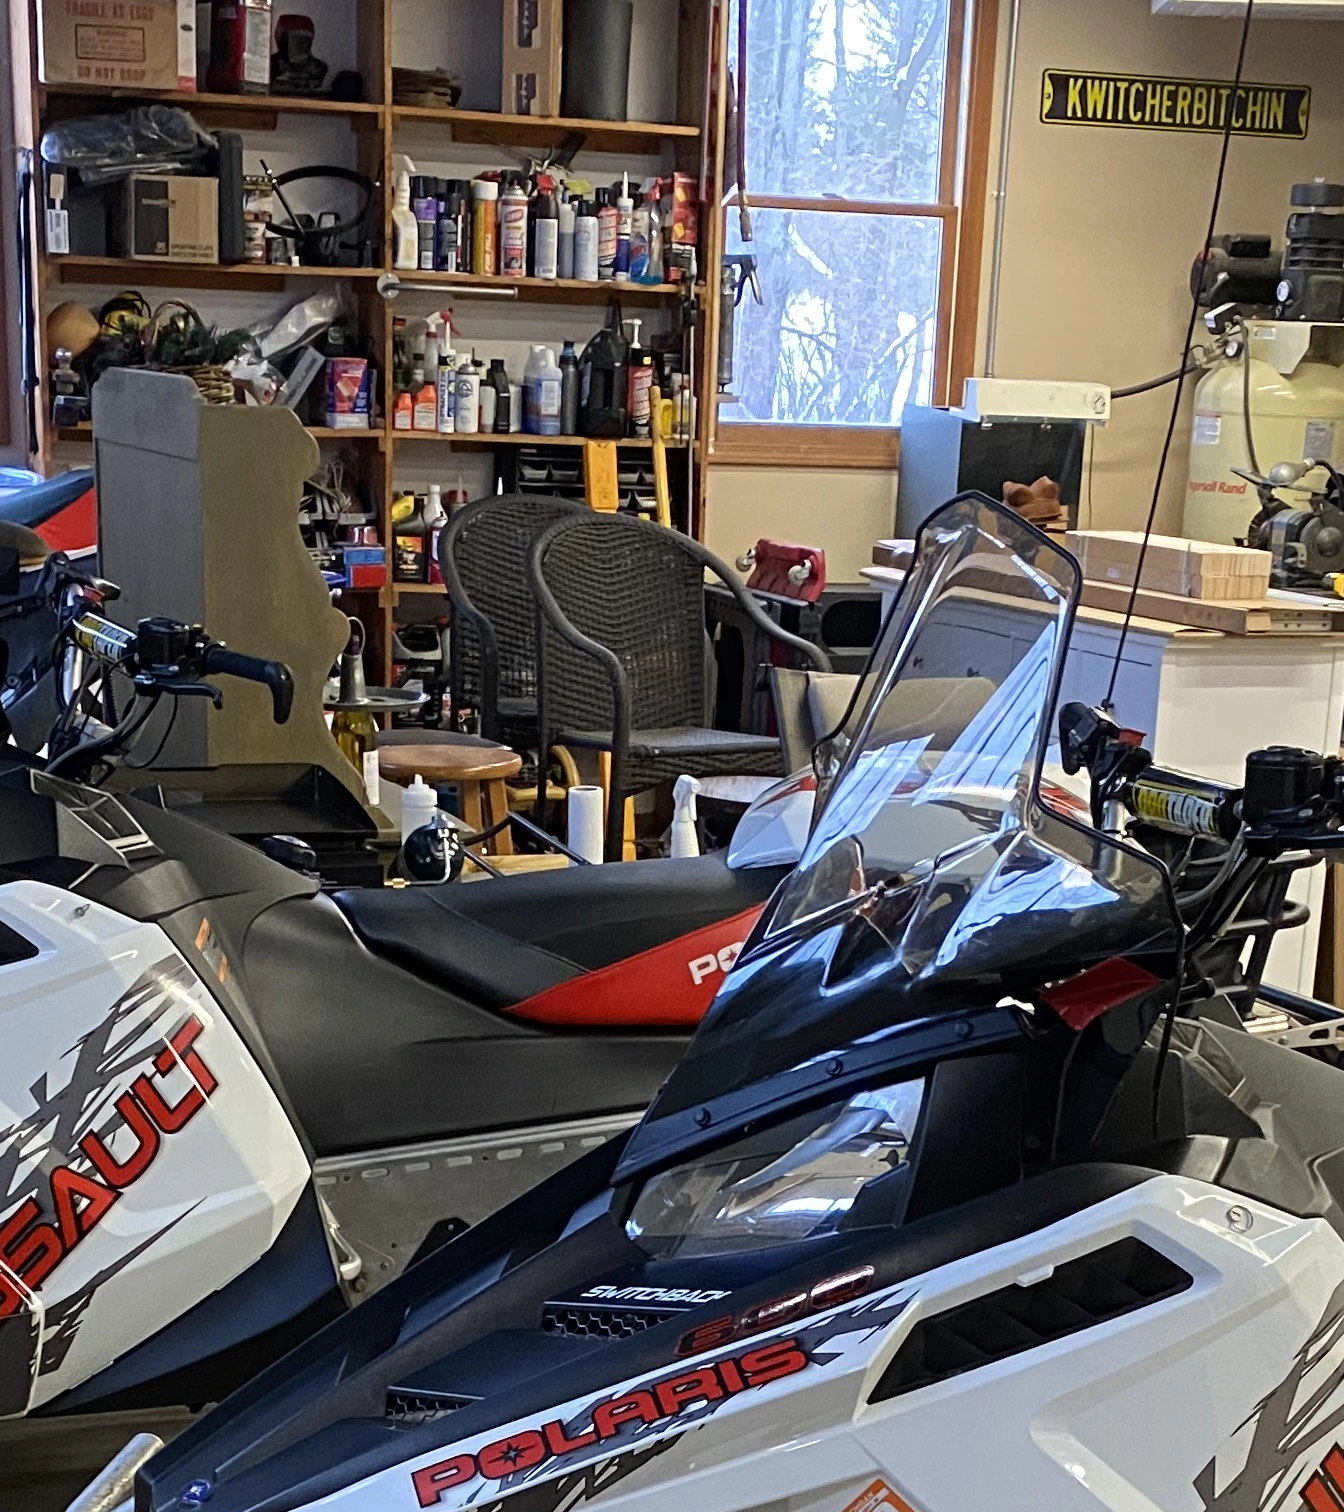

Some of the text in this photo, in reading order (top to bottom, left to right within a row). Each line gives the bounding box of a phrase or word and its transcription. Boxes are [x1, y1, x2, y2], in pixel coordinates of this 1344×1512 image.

[1066, 77, 1286, 131] KWITCHERBITCHIN
[1218, 481, 1248, 495] Rand
[580, 1284, 733, 1304] SWITCHBACK
[410, 1337, 810, 1509] POLARIS
